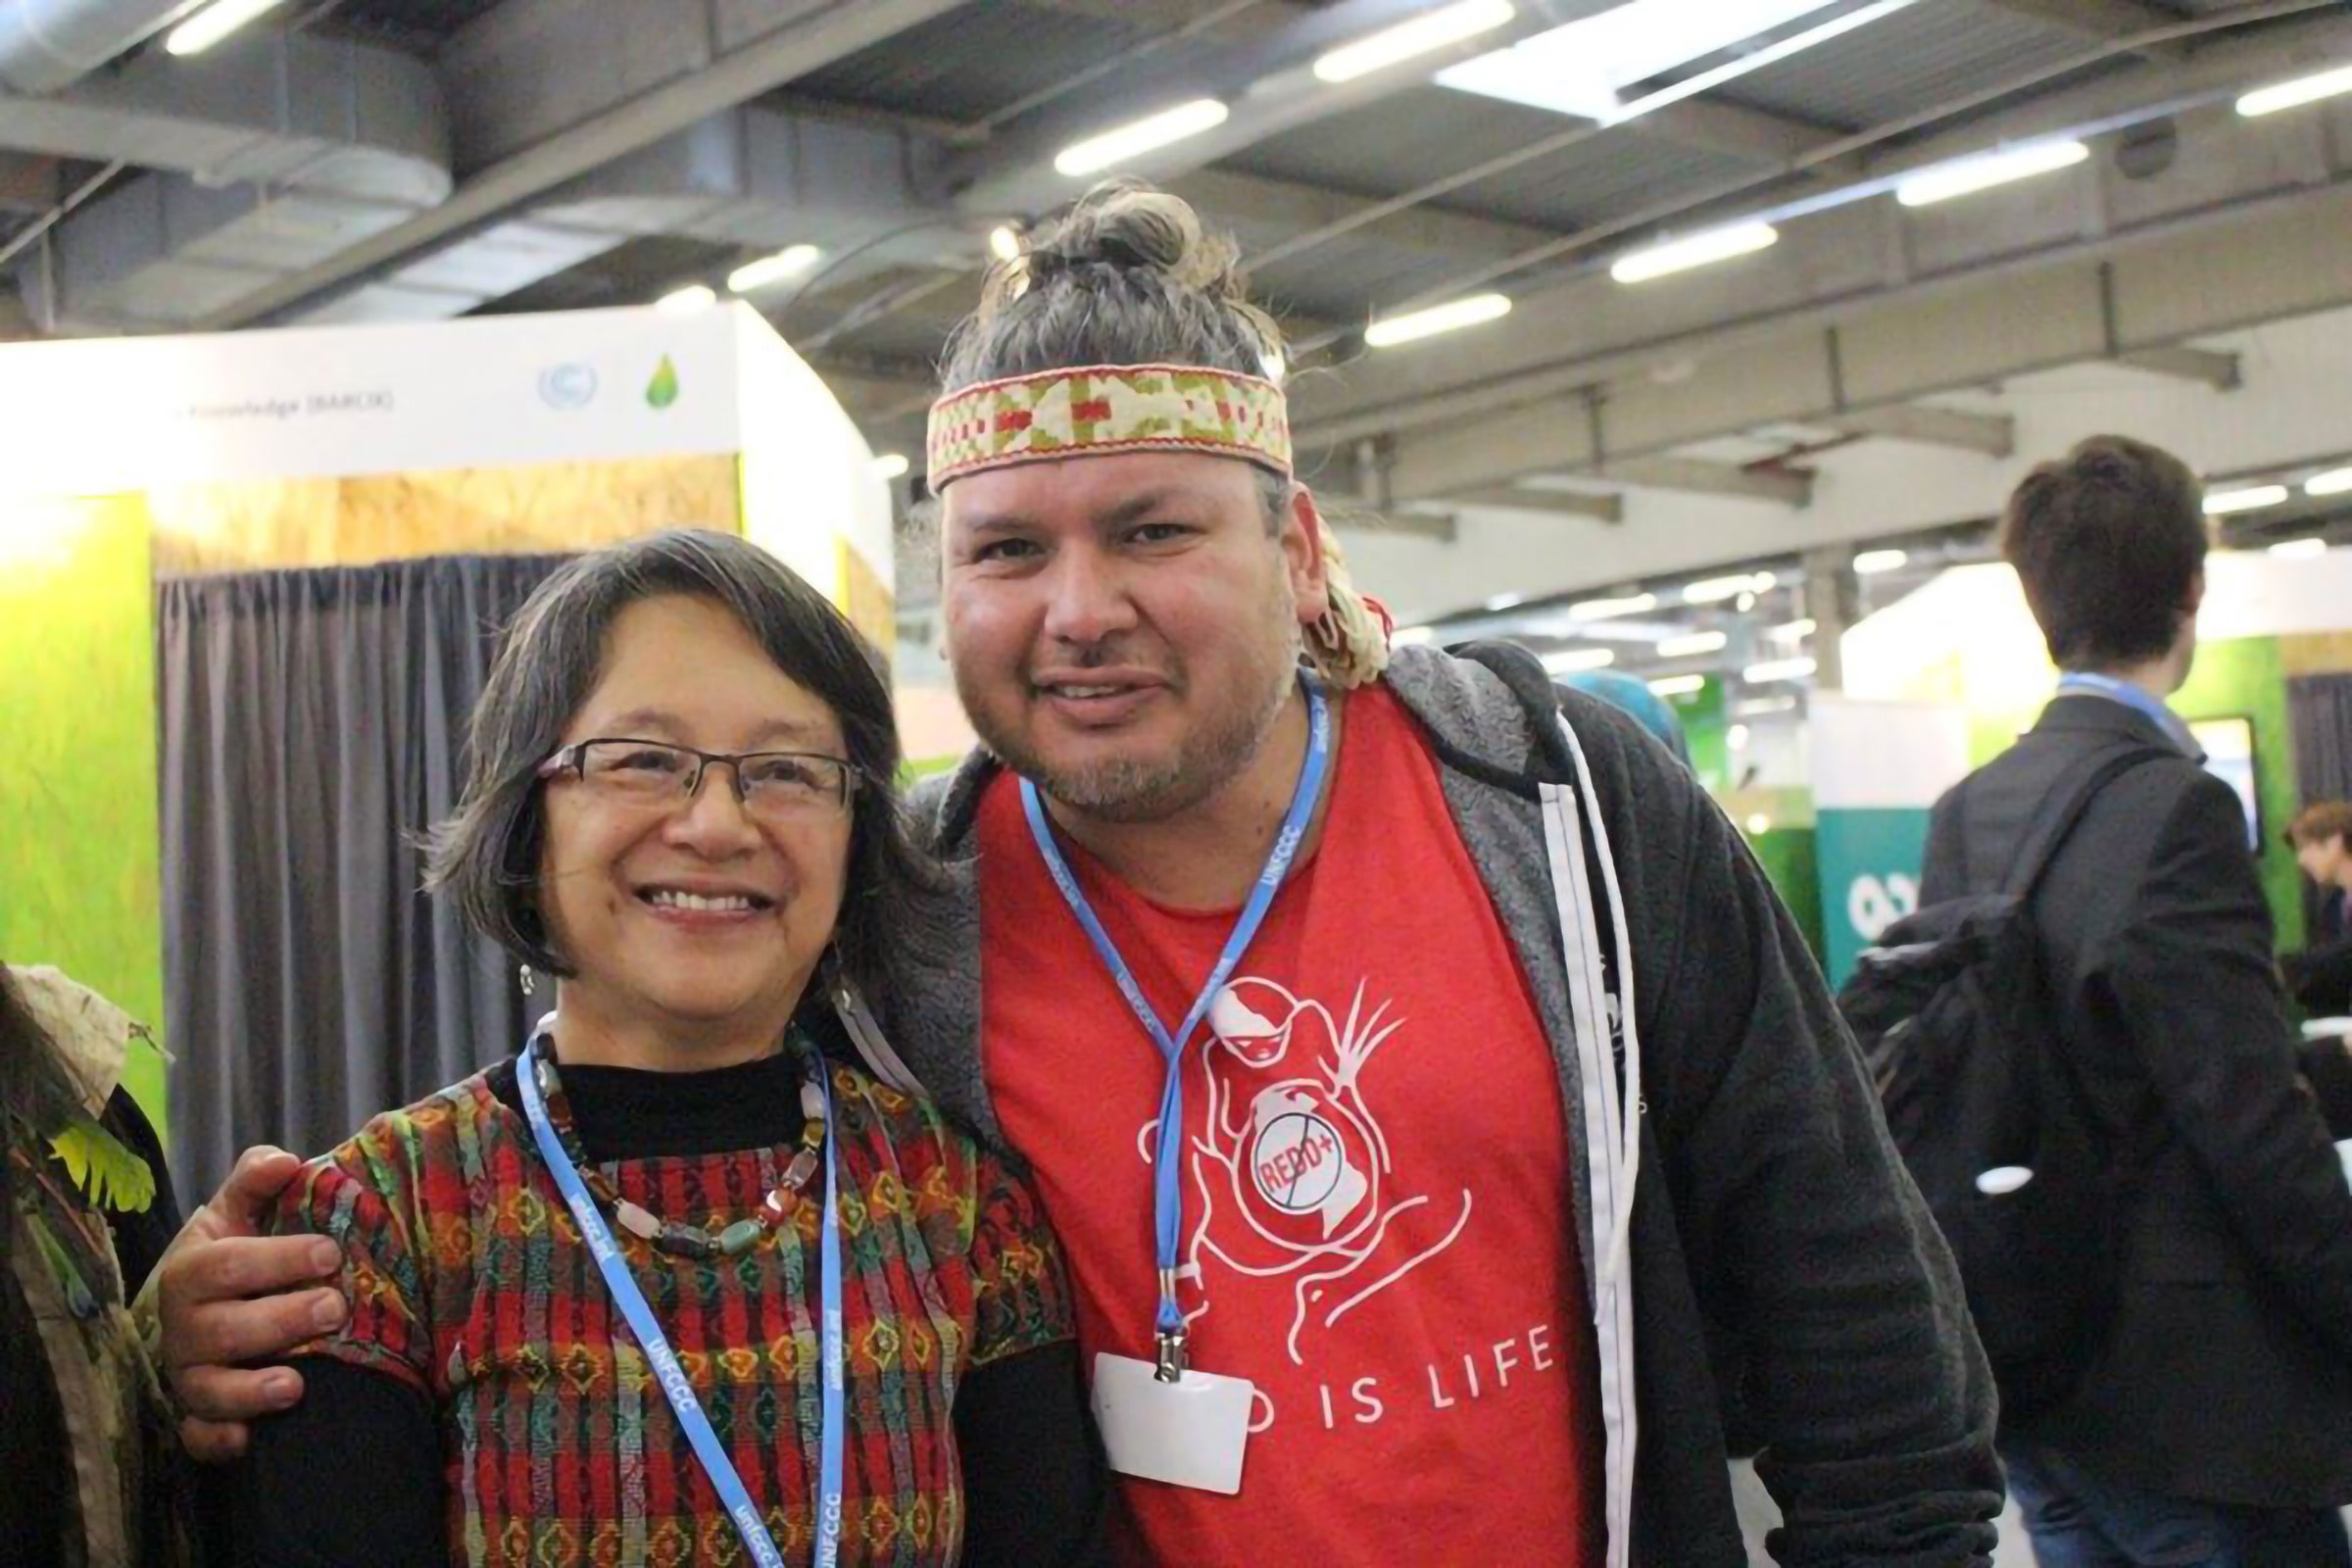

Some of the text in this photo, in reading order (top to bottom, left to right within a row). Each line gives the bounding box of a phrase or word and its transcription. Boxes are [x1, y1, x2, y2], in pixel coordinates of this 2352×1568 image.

[1260, 1134, 1333, 1193] REDD+
[647, 1339, 698, 1412] UNFCCC
[1320, 1377, 1383, 1430] IS
[1428, 1324, 1553, 1408] LIFE
